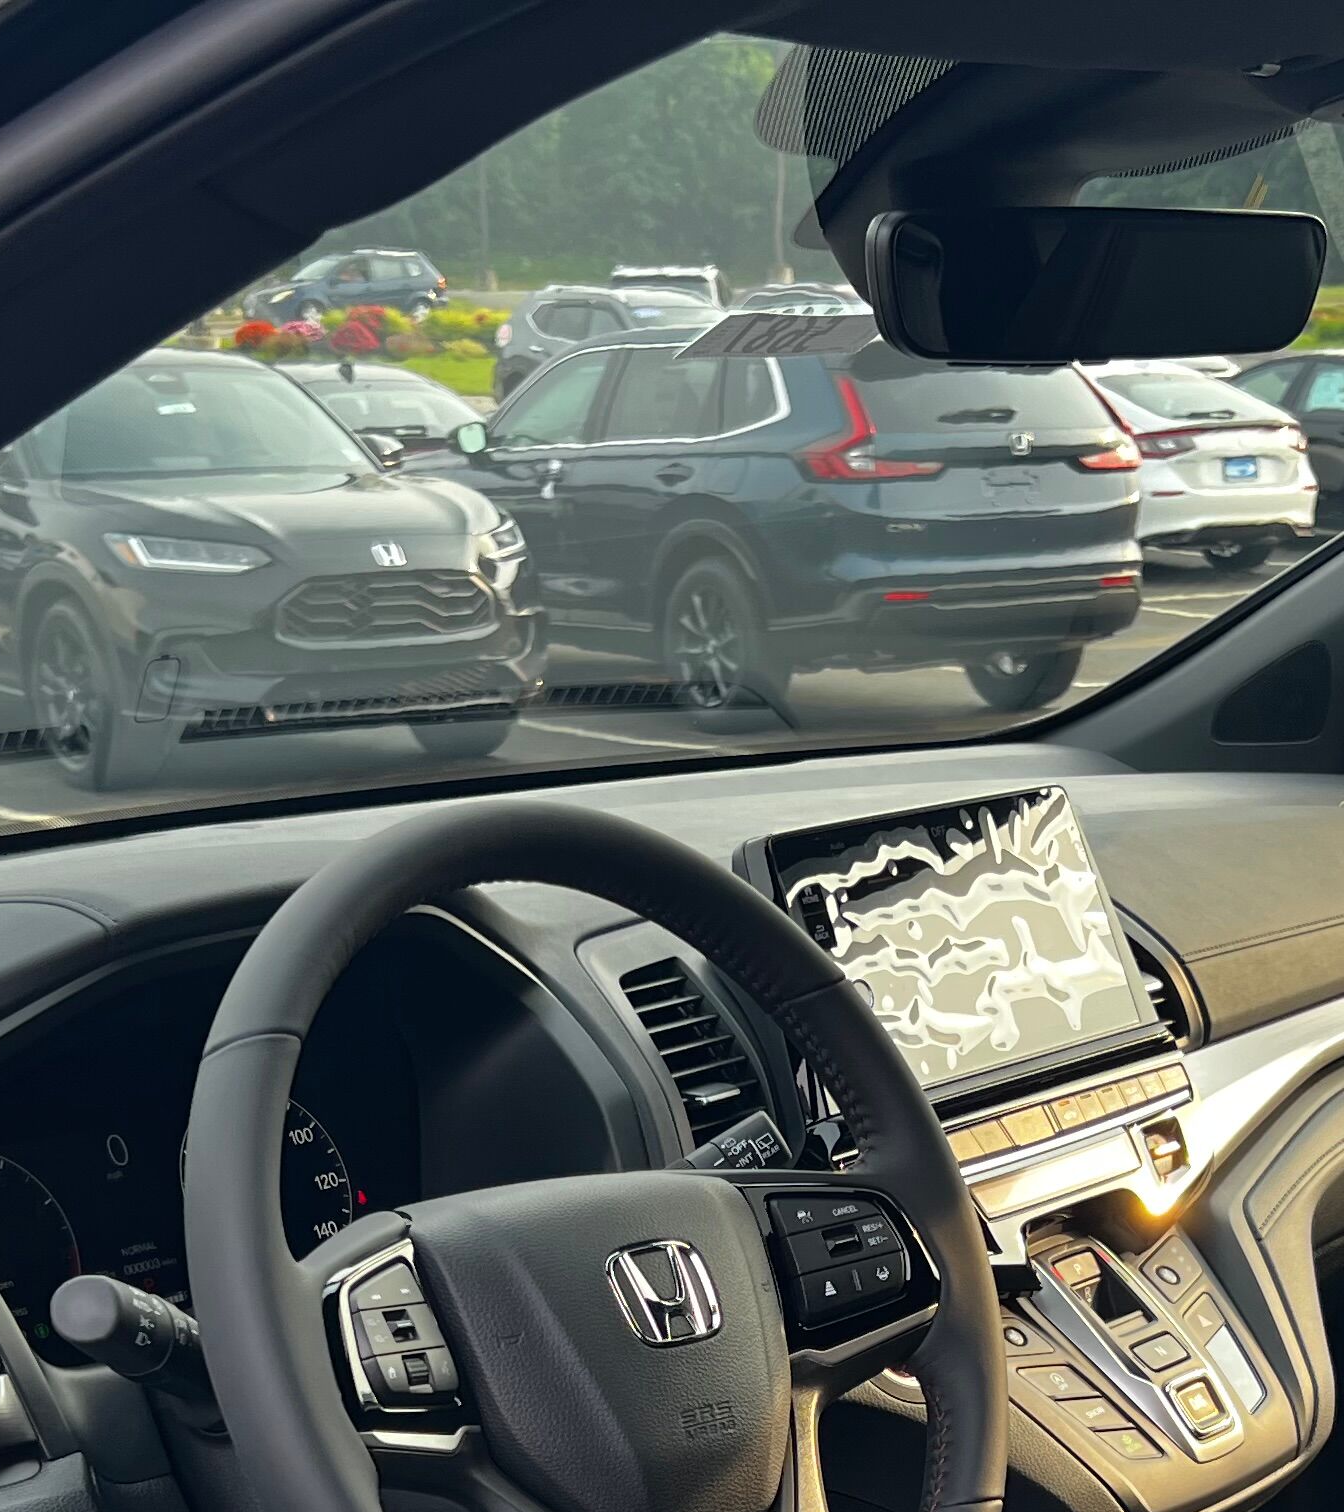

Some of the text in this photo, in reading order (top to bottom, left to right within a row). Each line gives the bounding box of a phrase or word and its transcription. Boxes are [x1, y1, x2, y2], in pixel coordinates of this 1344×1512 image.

[288, 1127, 314, 1145] 100
[106, 1134, 129, 1166] 0
[731, 1139, 748, 1155] OFF
[738, 1152, 754, 1167] INT
[314, 1172, 339, 1190] 120
[832, 1205, 859, 1217] CANCEL
[313, 1221, 338, 1239] 140
